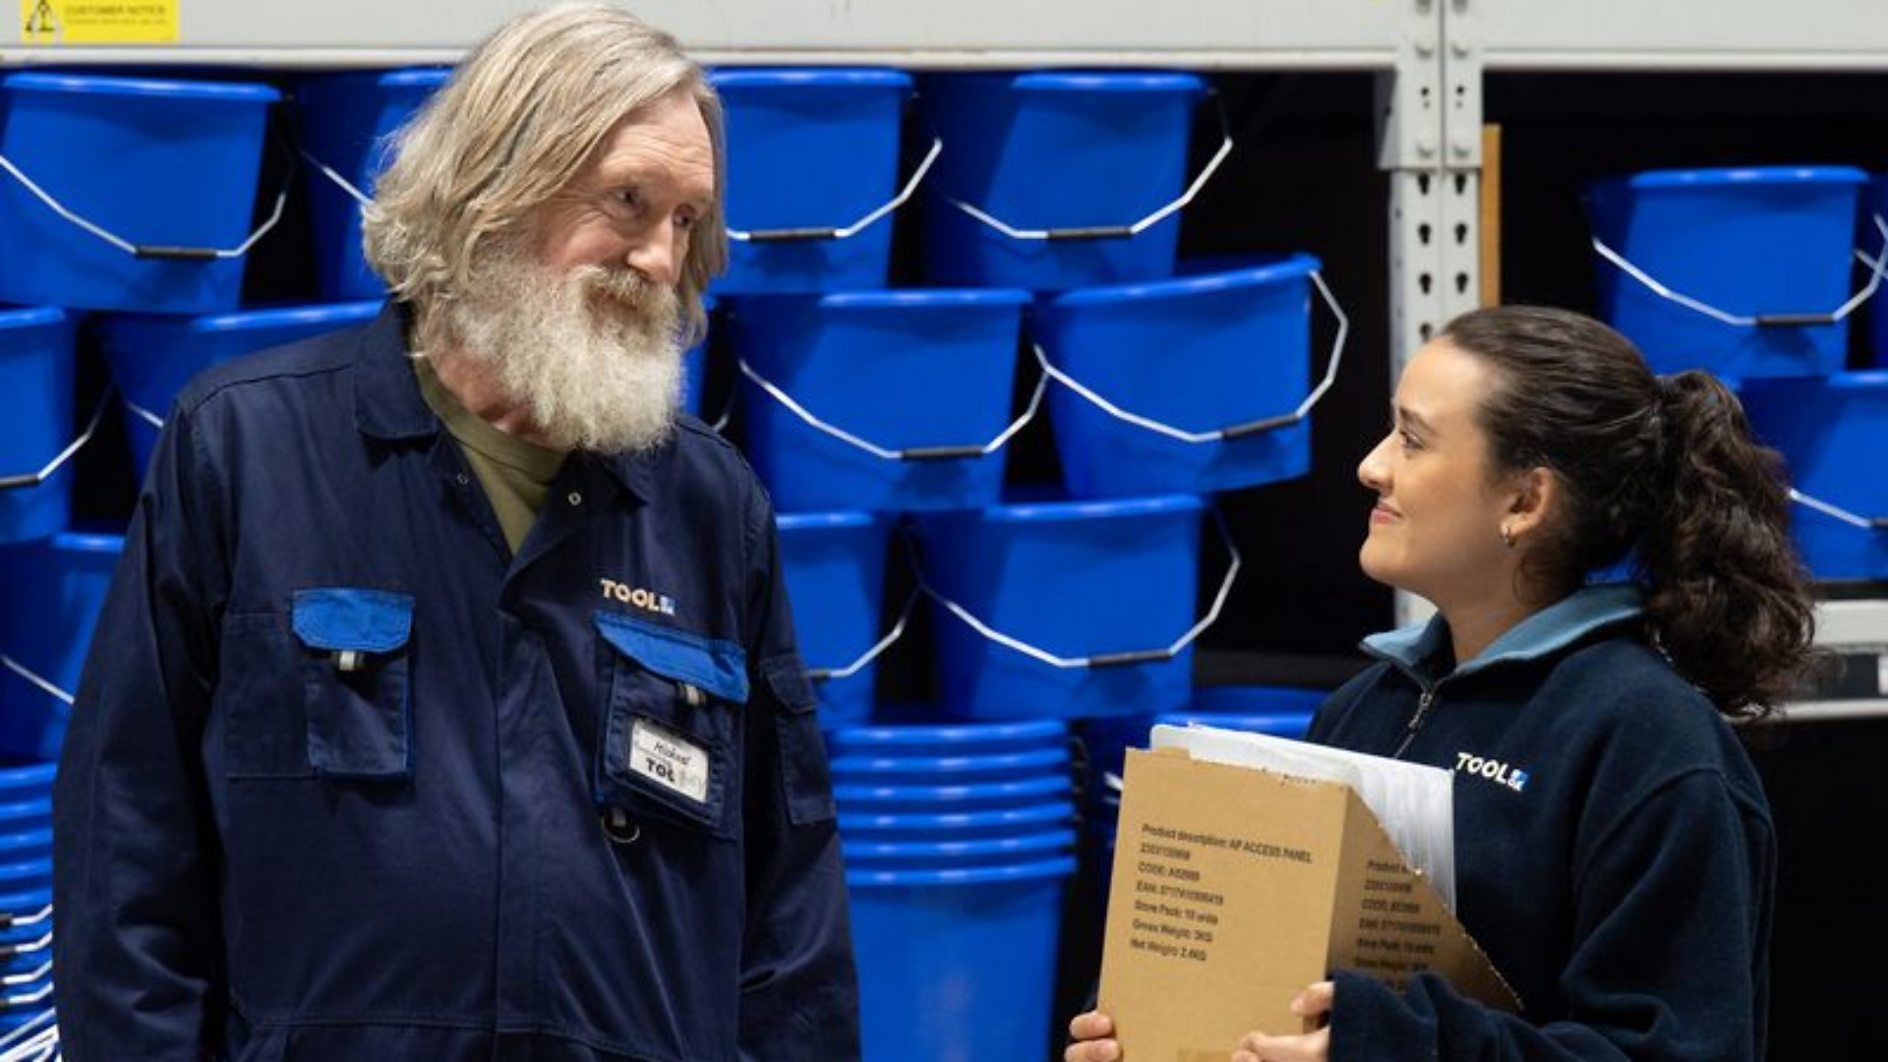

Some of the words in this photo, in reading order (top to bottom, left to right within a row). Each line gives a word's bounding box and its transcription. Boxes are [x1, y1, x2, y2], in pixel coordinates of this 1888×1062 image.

[1141, 823, 1176, 839] Product
[1229, 838, 1242, 851] AP
[1243, 841, 1281, 858] ACCESS
[1283, 847, 1313, 864] PANEL
[1132, 917, 1159, 931] Gross
[1160, 923, 1190, 940] Weight:
[1196, 913, 1218, 926] units
[1130, 938, 1145, 949] Net
[1146, 941, 1178, 957] Weight:
